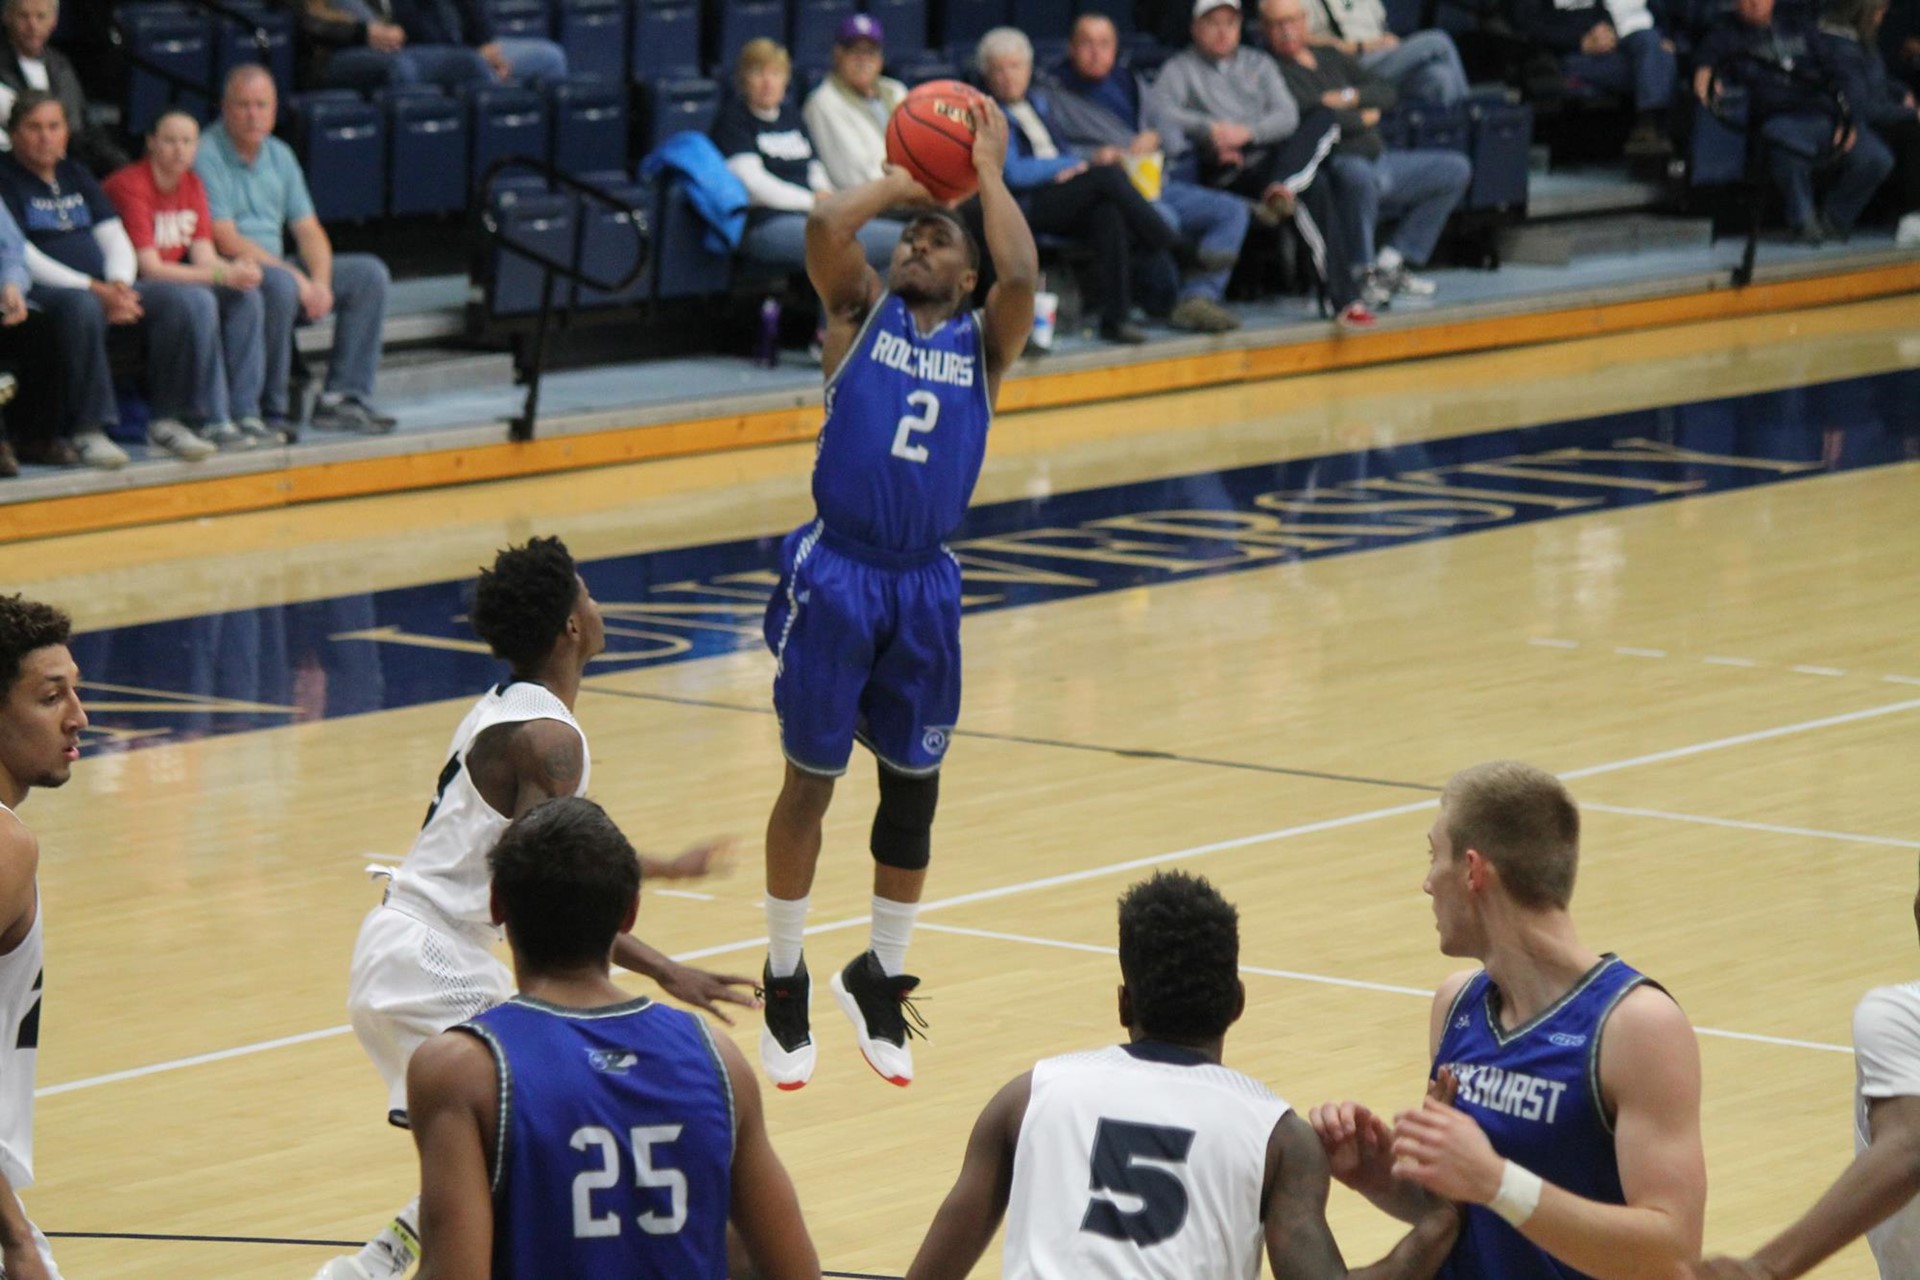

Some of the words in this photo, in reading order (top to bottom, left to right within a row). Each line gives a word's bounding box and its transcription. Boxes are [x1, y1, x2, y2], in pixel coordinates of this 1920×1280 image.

[891, 390, 940, 463] 2
[569, 1124, 688, 1238] 25
[1079, 1116, 1196, 1249] 5
